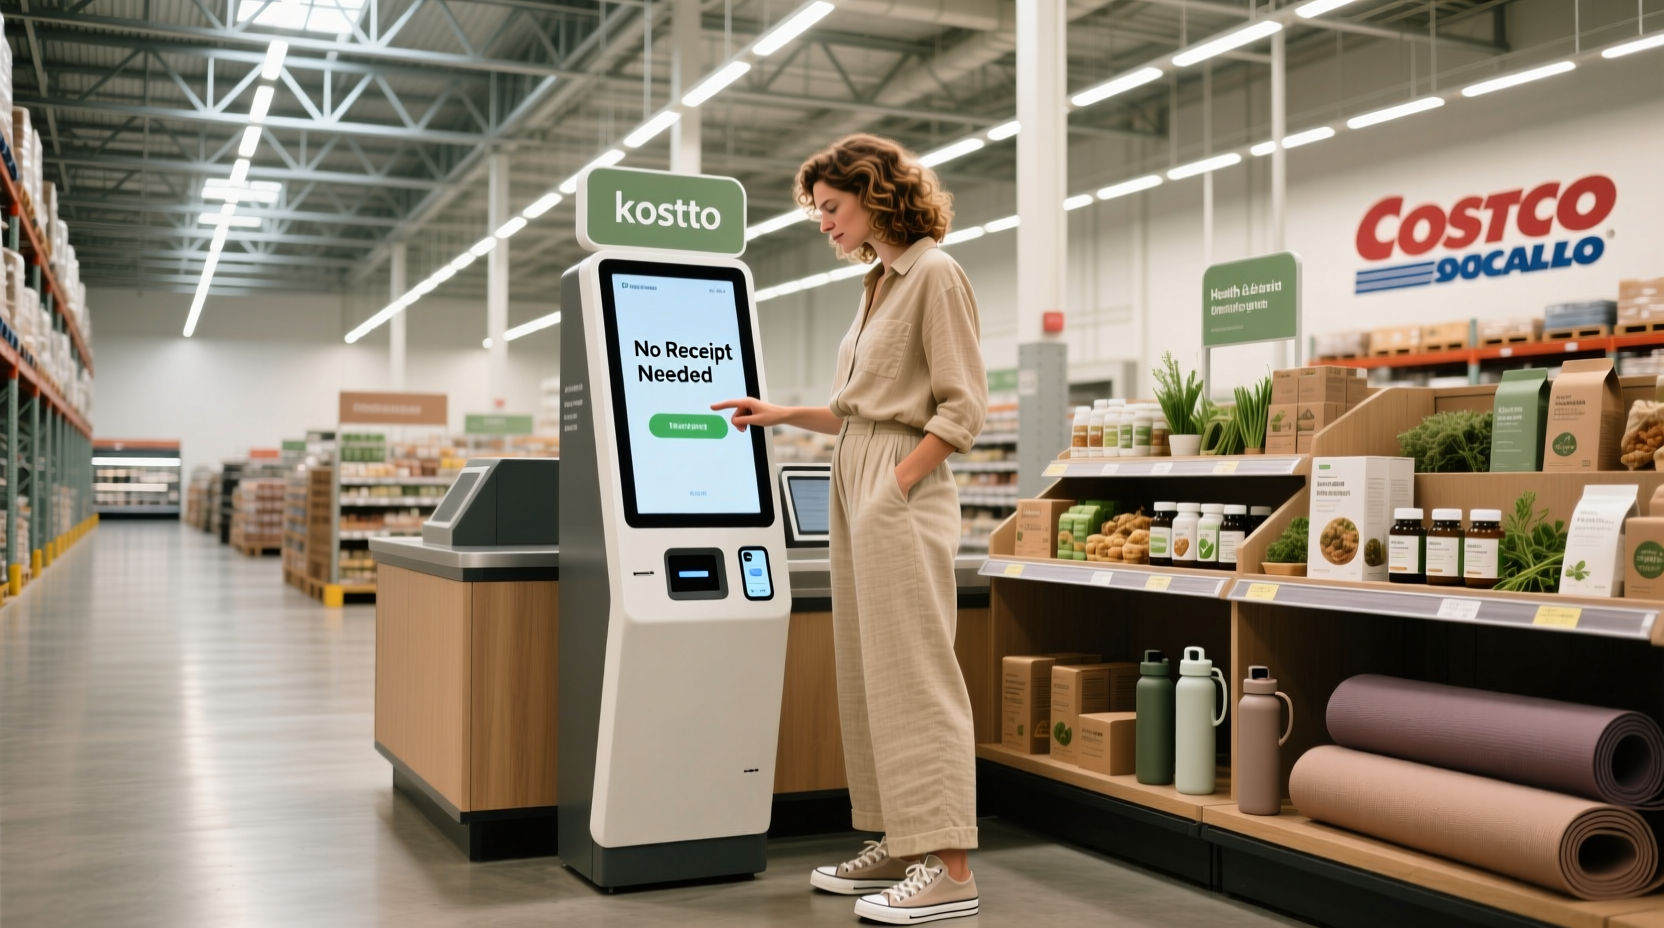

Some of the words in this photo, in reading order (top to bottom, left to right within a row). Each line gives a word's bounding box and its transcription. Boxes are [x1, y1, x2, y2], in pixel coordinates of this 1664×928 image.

[615, 191, 721, 230] kostto
[1356, 175, 1617, 261] COSTCO
[635, 340, 661, 357] No
[665, 341, 733, 365] Receipt
[638, 365, 713, 383] Needed
